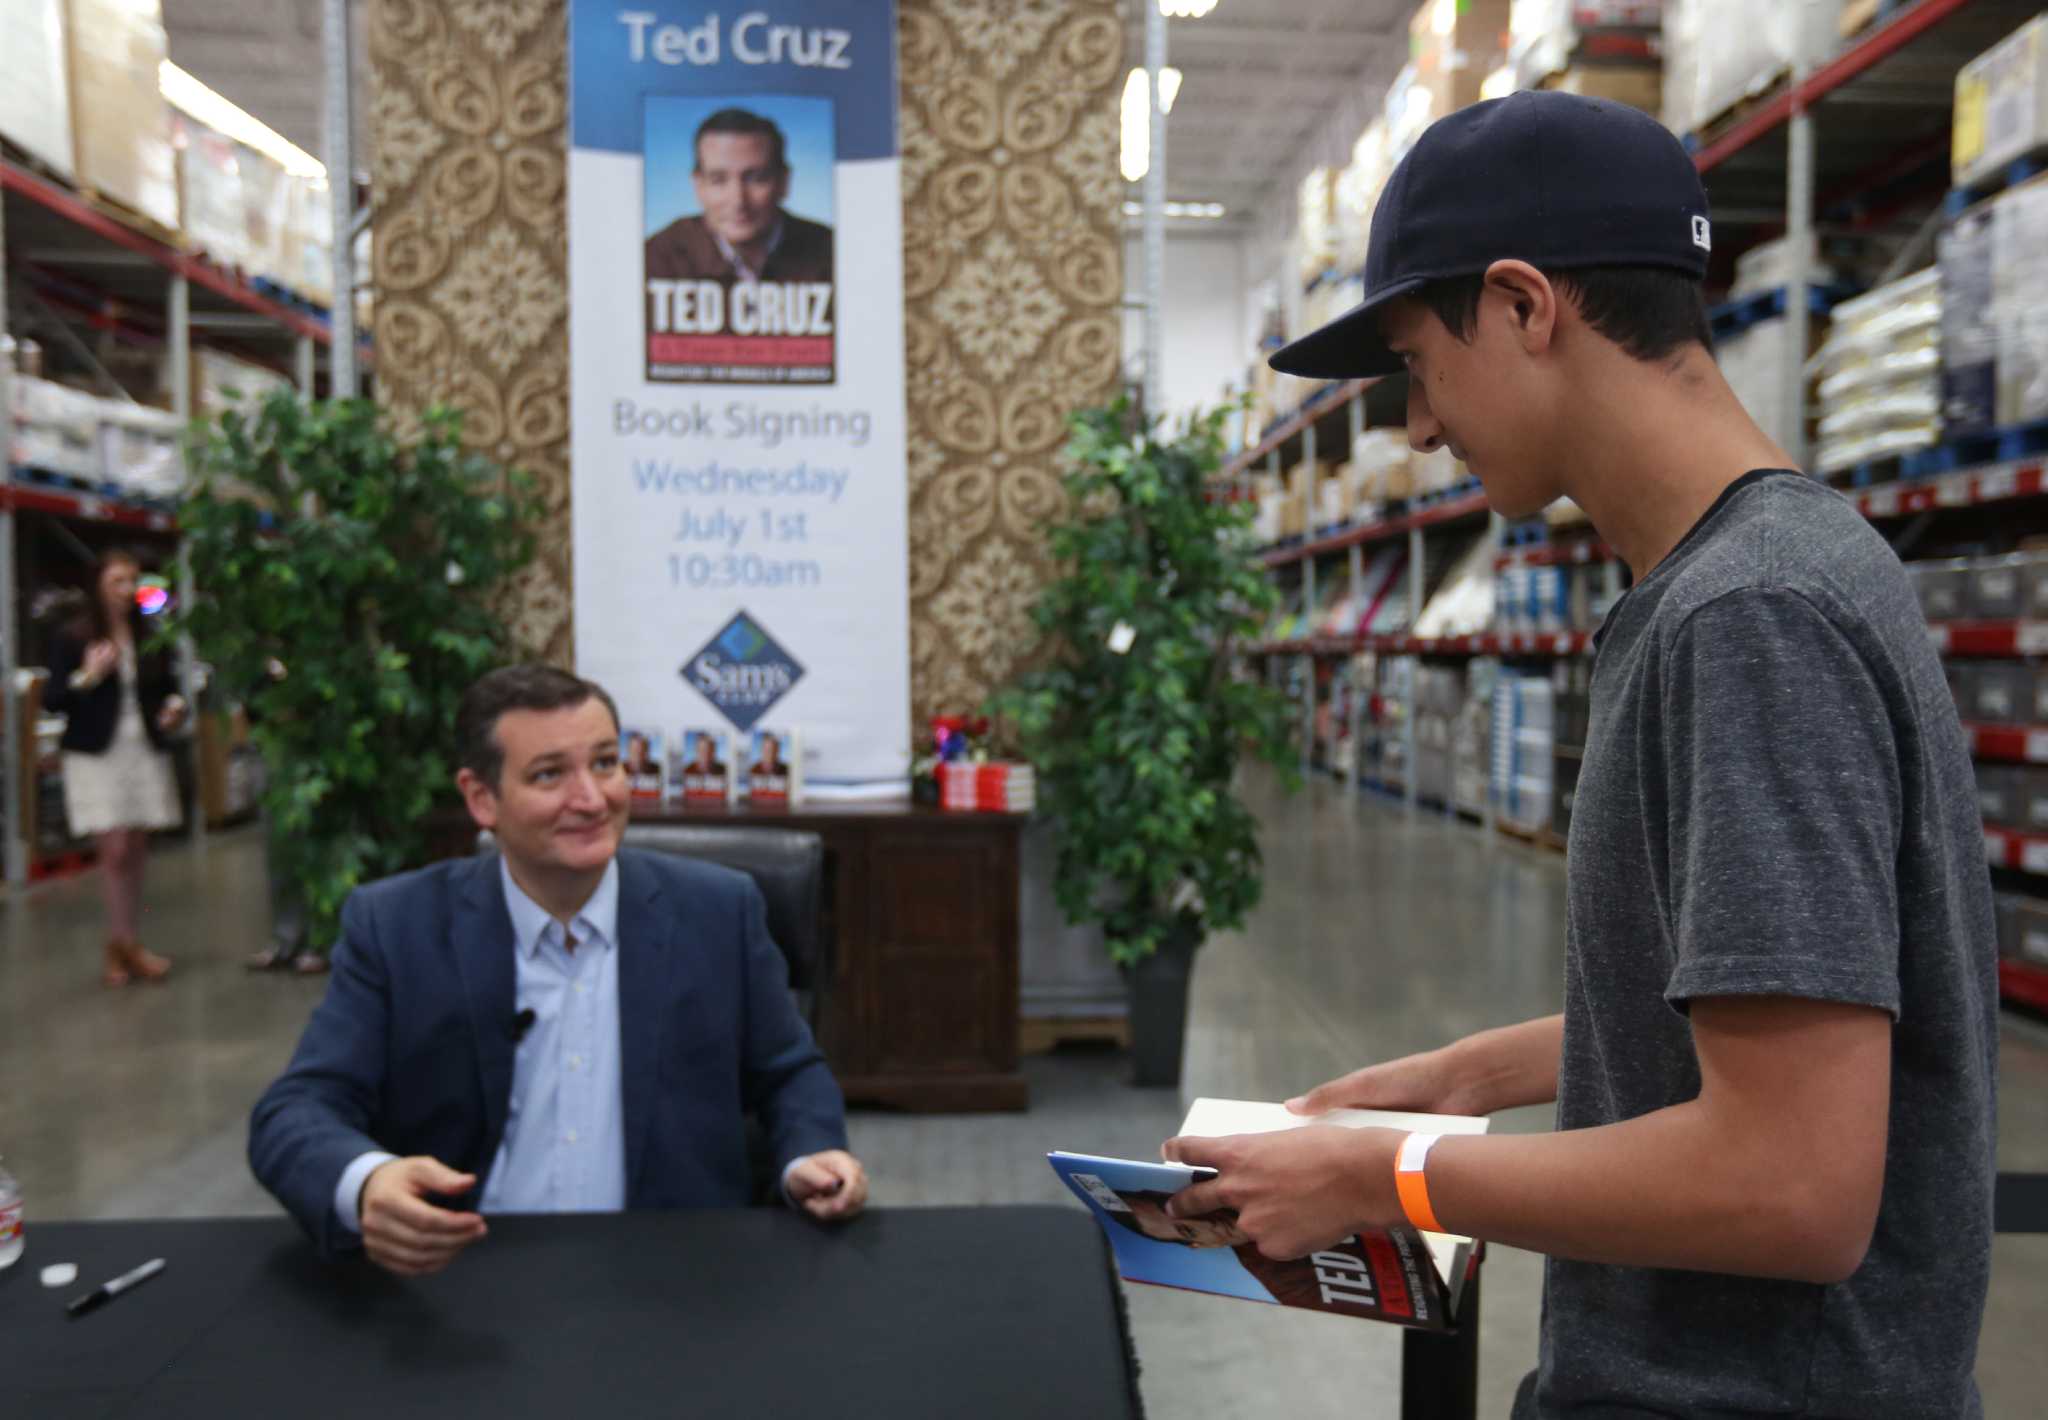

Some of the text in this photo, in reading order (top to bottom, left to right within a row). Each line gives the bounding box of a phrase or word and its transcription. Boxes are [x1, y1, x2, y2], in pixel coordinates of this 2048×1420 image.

[618, 10, 852, 69] Ted Cruz
[649, 278, 834, 335] TED CRUZ
[613, 399, 872, 447] Book Signing
[632, 459, 848, 502] Wednesday
[675, 508, 808, 548] July 1st
[669, 553, 821, 587] 10:30am
[1311, 1250, 1376, 1305] TED
